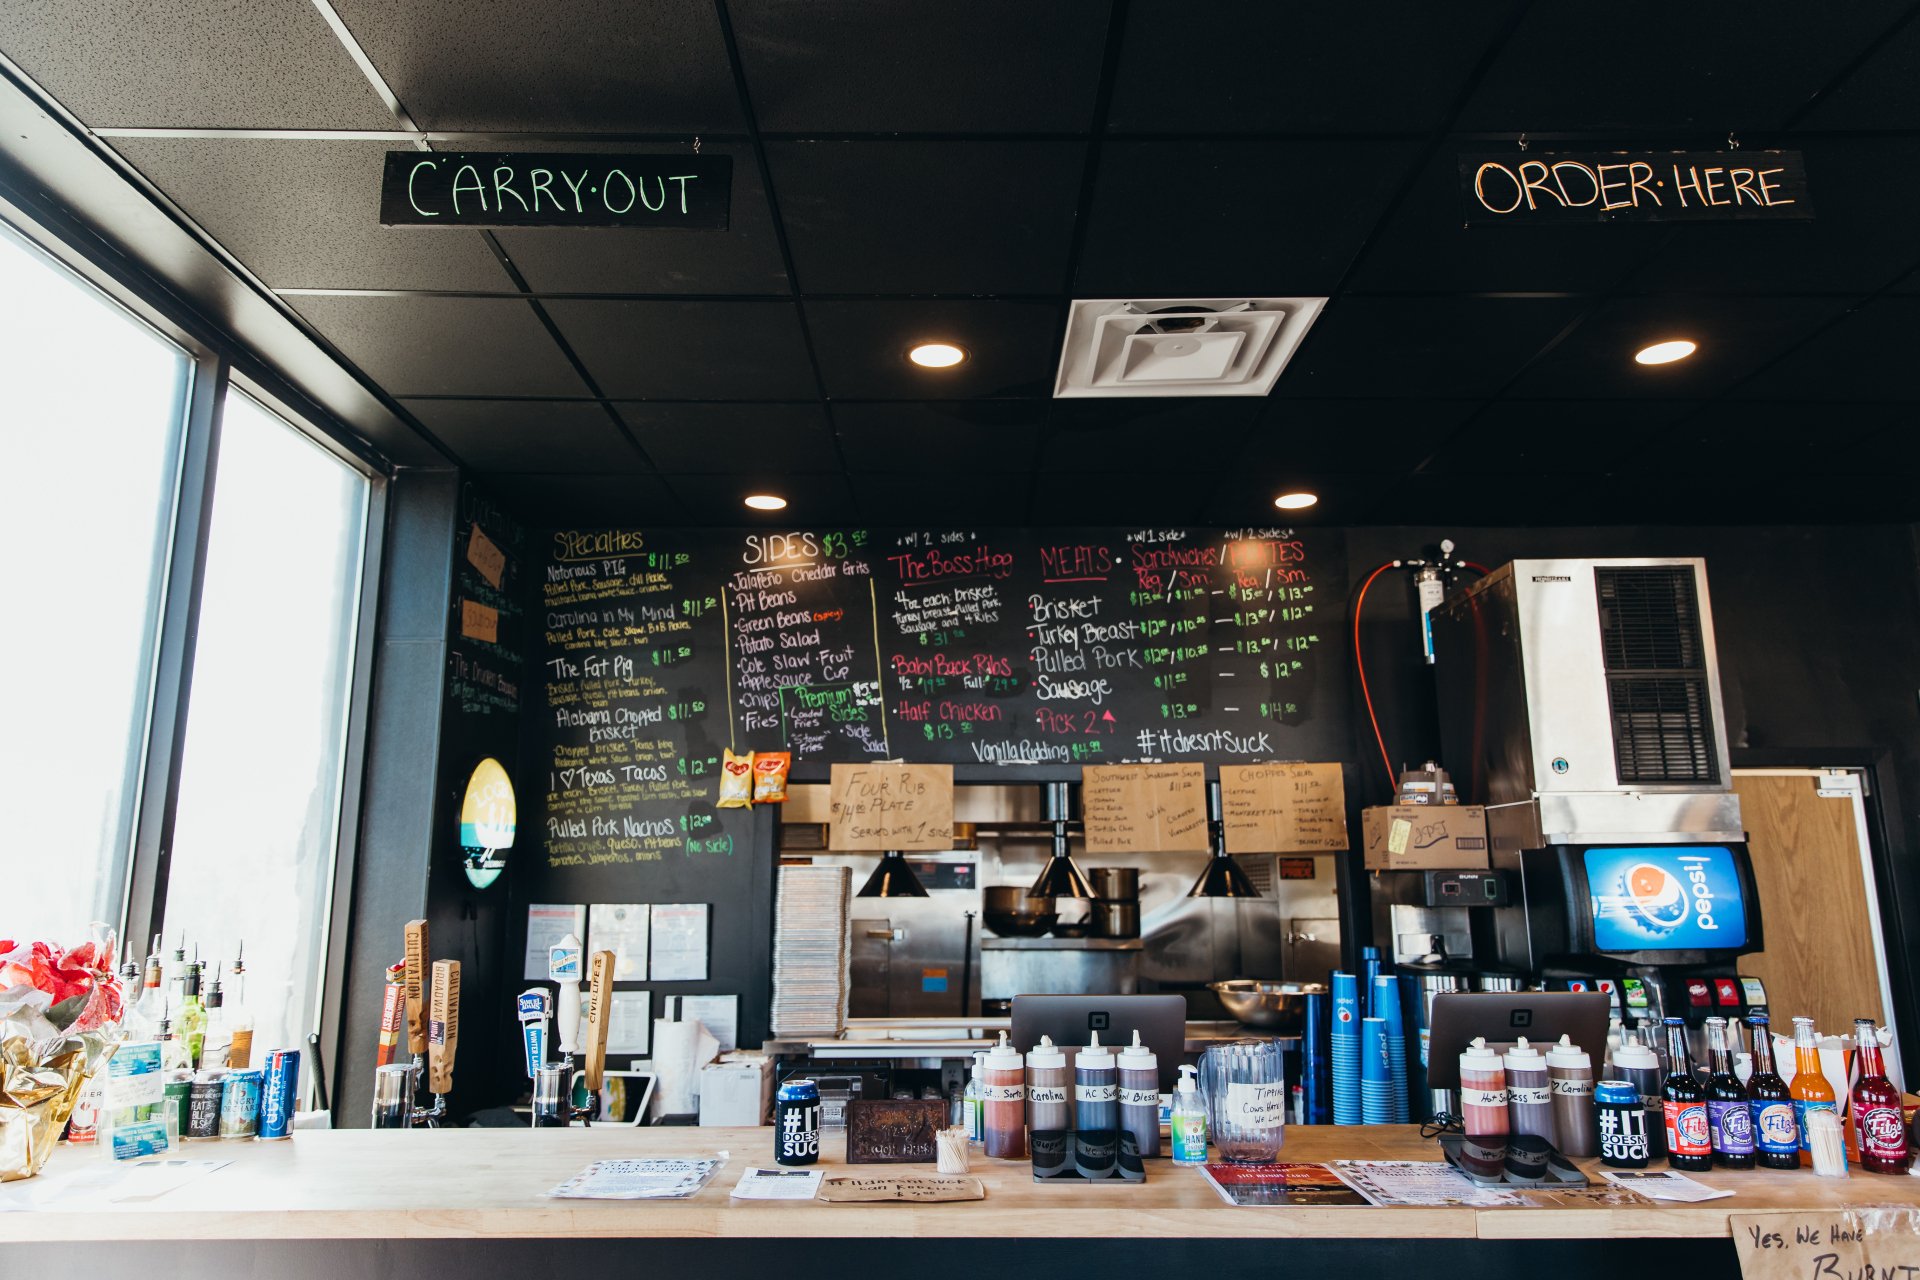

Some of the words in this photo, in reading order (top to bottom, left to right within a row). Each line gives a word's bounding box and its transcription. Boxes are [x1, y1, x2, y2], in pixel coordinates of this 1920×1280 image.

[743, 532, 818, 564] SIDES
[1132, 543, 1217, 569] Sandwiches
[1040, 545, 1112, 577] MEATS
[547, 563, 596, 582] Notorious
[792, 563, 837, 583] Cheddar
[843, 561, 870, 576] Grits
[736, 593, 756, 613] Pit
[759, 590, 797, 610] Beans
[1029, 594, 1102, 622] Brisket
[547, 611, 598, 628] Carolina
[603, 609, 614, 622] in
[618, 608, 634, 626] My
[642, 603, 675, 620] Mind
[738, 617, 774, 634] Green
[777, 611, 812, 629] Beans
[941, 617, 959, 627] and
[738, 635, 774, 655] Potato
[780, 628, 820, 648] Salad
[1026, 623, 1079, 652] Turkey
[1081, 620, 1140, 644] Breast
[546, 658, 580, 679] The
[584, 655, 610, 678] Fat
[614, 655, 634, 682] Pig
[740, 658, 766, 674] Cole
[773, 652, 810, 670] Slaw
[819, 645, 855, 666] Fruit
[892, 654, 933, 676] Baby
[934, 654, 972, 675] Back
[973, 654, 1012, 677] Ribs
[1031, 646, 1085, 673] Pulled
[1091, 646, 1143, 669] Pork
[823, 666, 850, 681] Cup
[795, 687, 852, 708] Premium
[1037, 675, 1112, 705] Sausage
[743, 692, 779, 710] Chips
[899, 701, 931, 721] Half
[939, 702, 1002, 721] Chicken
[556, 708, 610, 728] Alabama
[615, 705, 662, 727] Chopped
[745, 711, 779, 732] Fries
[790, 706, 823, 718] Loaded
[829, 704, 868, 721] Sides
[1036, 708, 1077, 734] Pick
[1084, 710, 1100, 734] 2
[589, 724, 638, 743] Brisket
[794, 719, 820, 728] Fries
[845, 724, 871, 738] Side
[800, 743, 823, 754] Fries
[971, 739, 1019, 763] Vanilla
[576, 765, 616, 787] Texas
[620, 765, 667, 782] Tacos
[870, 798, 913, 812] PLATE
[547, 816, 587, 838] Pulled
[592, 816, 619, 836] Pork
[623, 816, 674, 837] Nachos
[406, 932, 420, 1000] CULTIVATION
[447, 970, 460, 1040] CULTIVATION
[520, 998, 542, 1006] SAMUEL
[530, 1031, 538, 1054] WINTER
[266, 1074, 282, 1123] ULTRA
[1031, 1091, 1065, 1101] Carolina
[1085, 1088, 1097, 1099] KC
[1133, 1094, 1155, 1102] Bless
[1481, 1092, 1497, 1102] Hot
[191, 1101, 205, 1110] FLAT
[192, 1111, 204, 1119] BILL
[191, 1120, 204, 1128] PILS
[1599, 1109, 1645, 1135] #IT
[1869, 1117, 1902, 1138] Fitz's
[1602, 1145, 1649, 1160] SUCK
[1796, 1225, 1820, 1245] WE
[1830, 1224, 1863, 1244] HAVE
